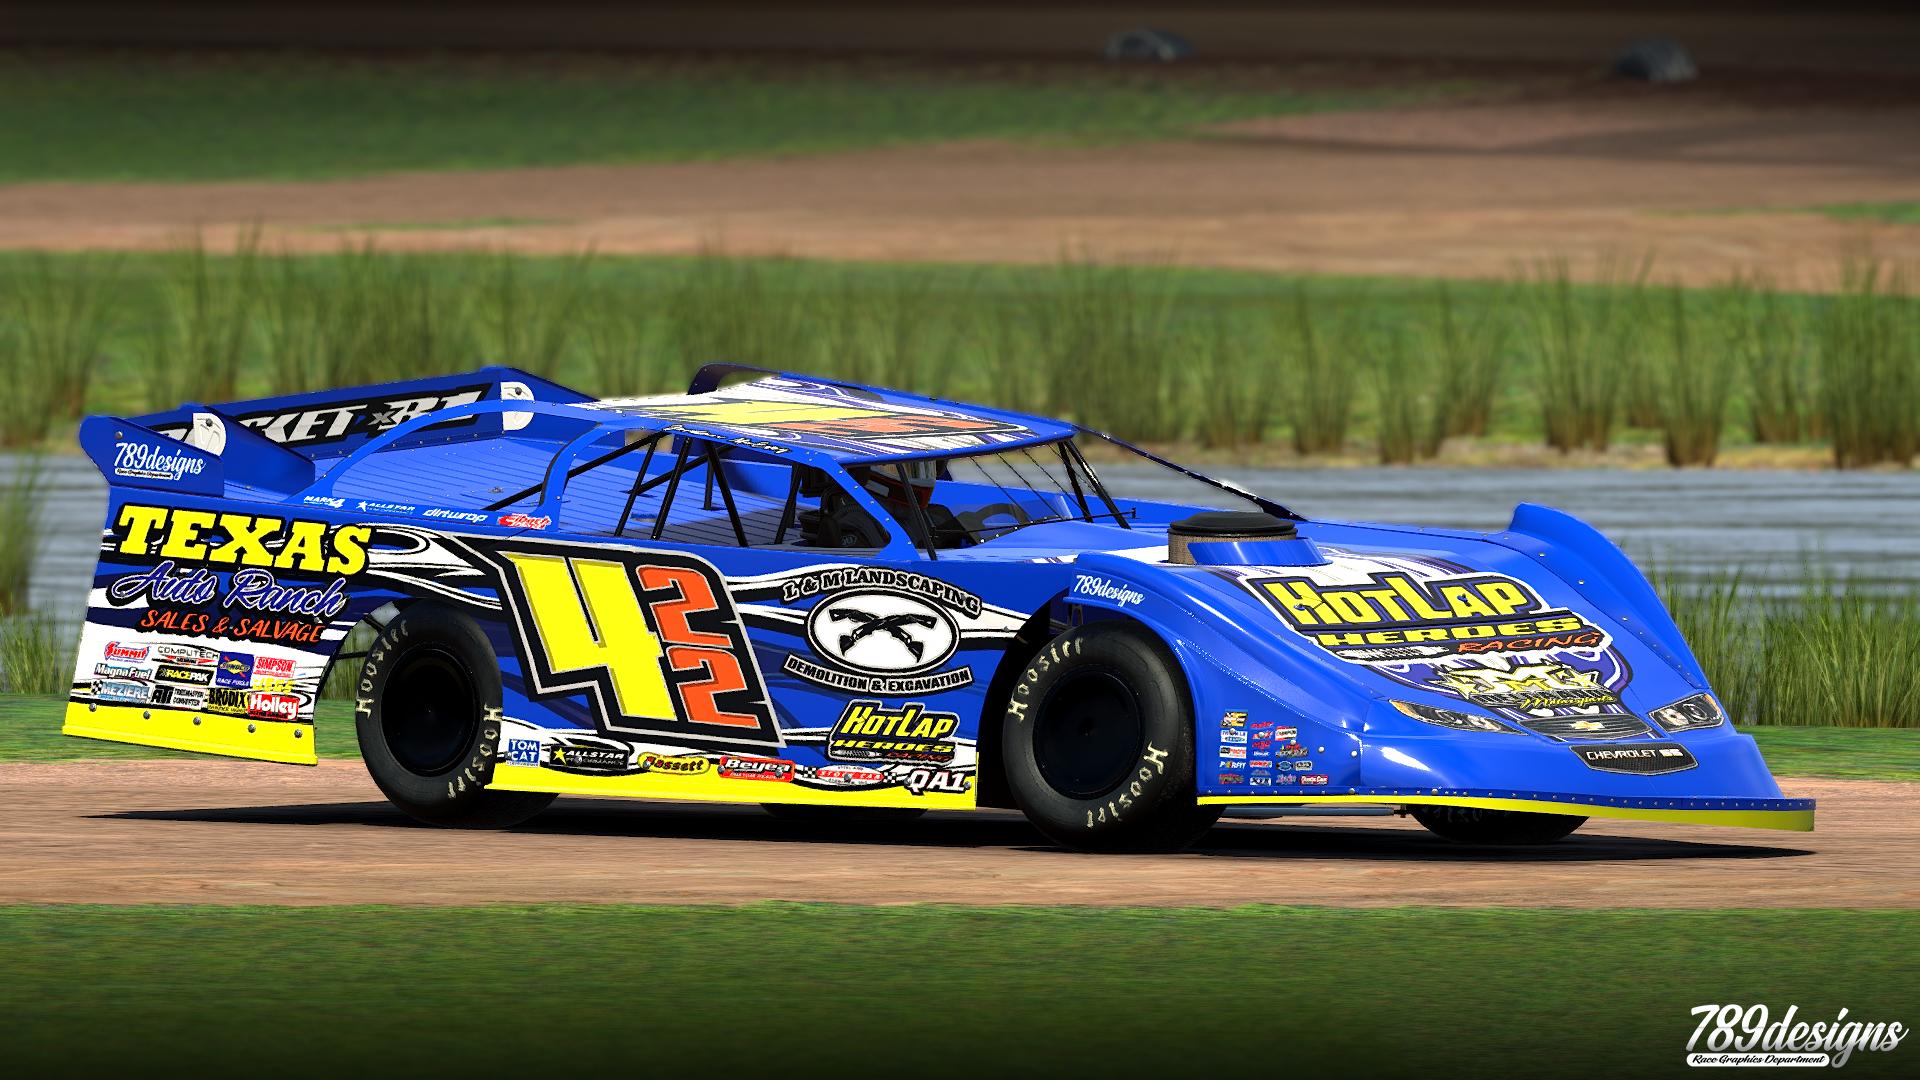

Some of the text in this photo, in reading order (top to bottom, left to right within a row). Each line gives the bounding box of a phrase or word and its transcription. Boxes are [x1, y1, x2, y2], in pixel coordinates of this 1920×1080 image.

[114, 443, 206, 480] 789designs
[118, 505, 371, 575] TEXAS
[112, 561, 346, 616] Auto Ranch
[784, 568, 981, 615] L & M LANDSCAPING
[1073, 574, 1146, 607] 789designs
[141, 610, 326, 643] SALES & SALVAGE
[1312, 616, 1583, 646] HEROES
[157, 646, 219, 659] COMPUTECH
[1456, 632, 1602, 653] RACING
[256, 658, 293, 672] SIMPSON
[785, 655, 972, 692] DEMOLITION & EXCAVATION
[208, 688, 246, 708] BRODIX
[250, 693, 297, 719] Holley
[510, 740, 537, 751] TOM
[511, 751, 537, 762] CAT
[565, 750, 625, 759] ALLSTAR
[833, 739, 954, 753] HEROES
[1586, 749, 1657, 760] CHEVROLET
[909, 770, 965, 793] QA1
